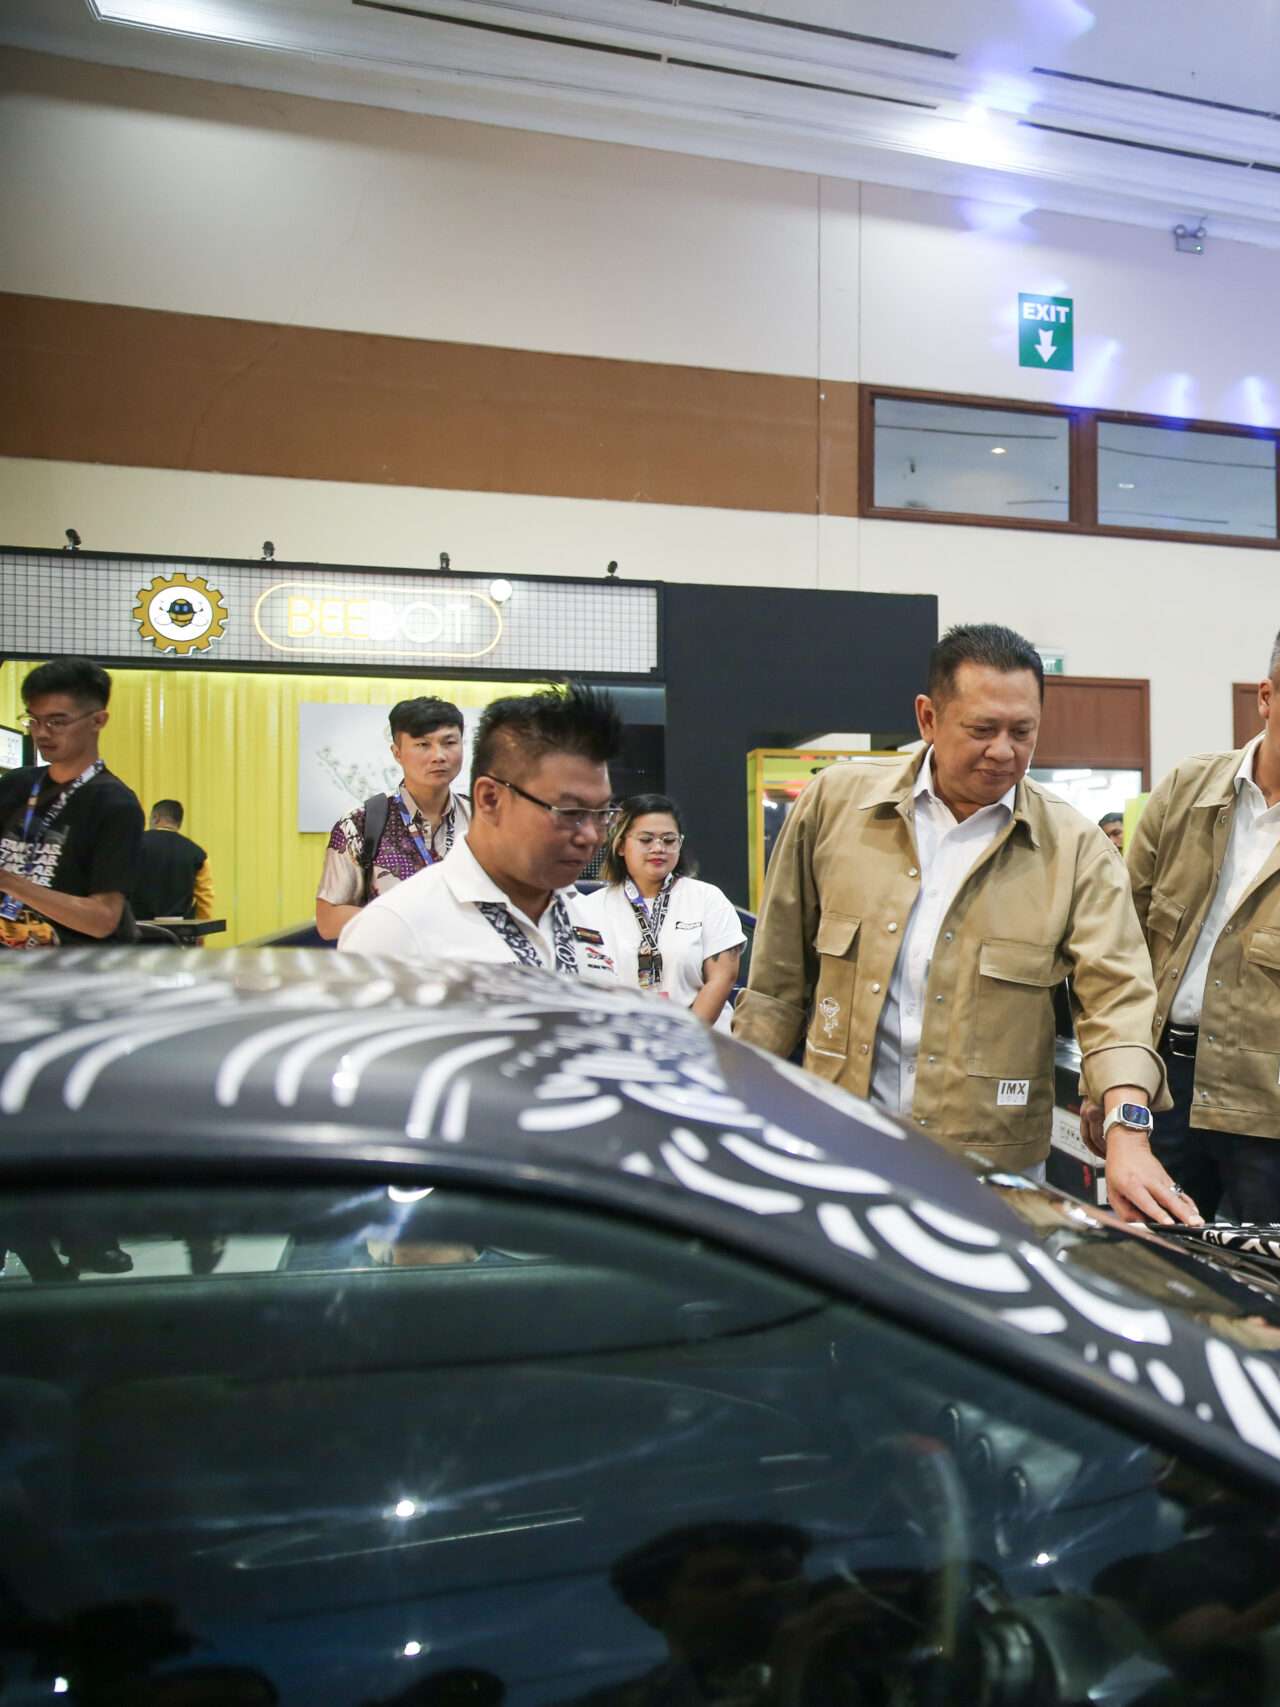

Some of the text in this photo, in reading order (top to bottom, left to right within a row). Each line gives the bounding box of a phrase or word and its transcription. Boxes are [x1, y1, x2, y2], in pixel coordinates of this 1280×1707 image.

[1023, 301, 1069, 323] EXIT
[287, 595, 470, 644] BEEBOT
[1000, 1082, 1026, 1095] IMX
